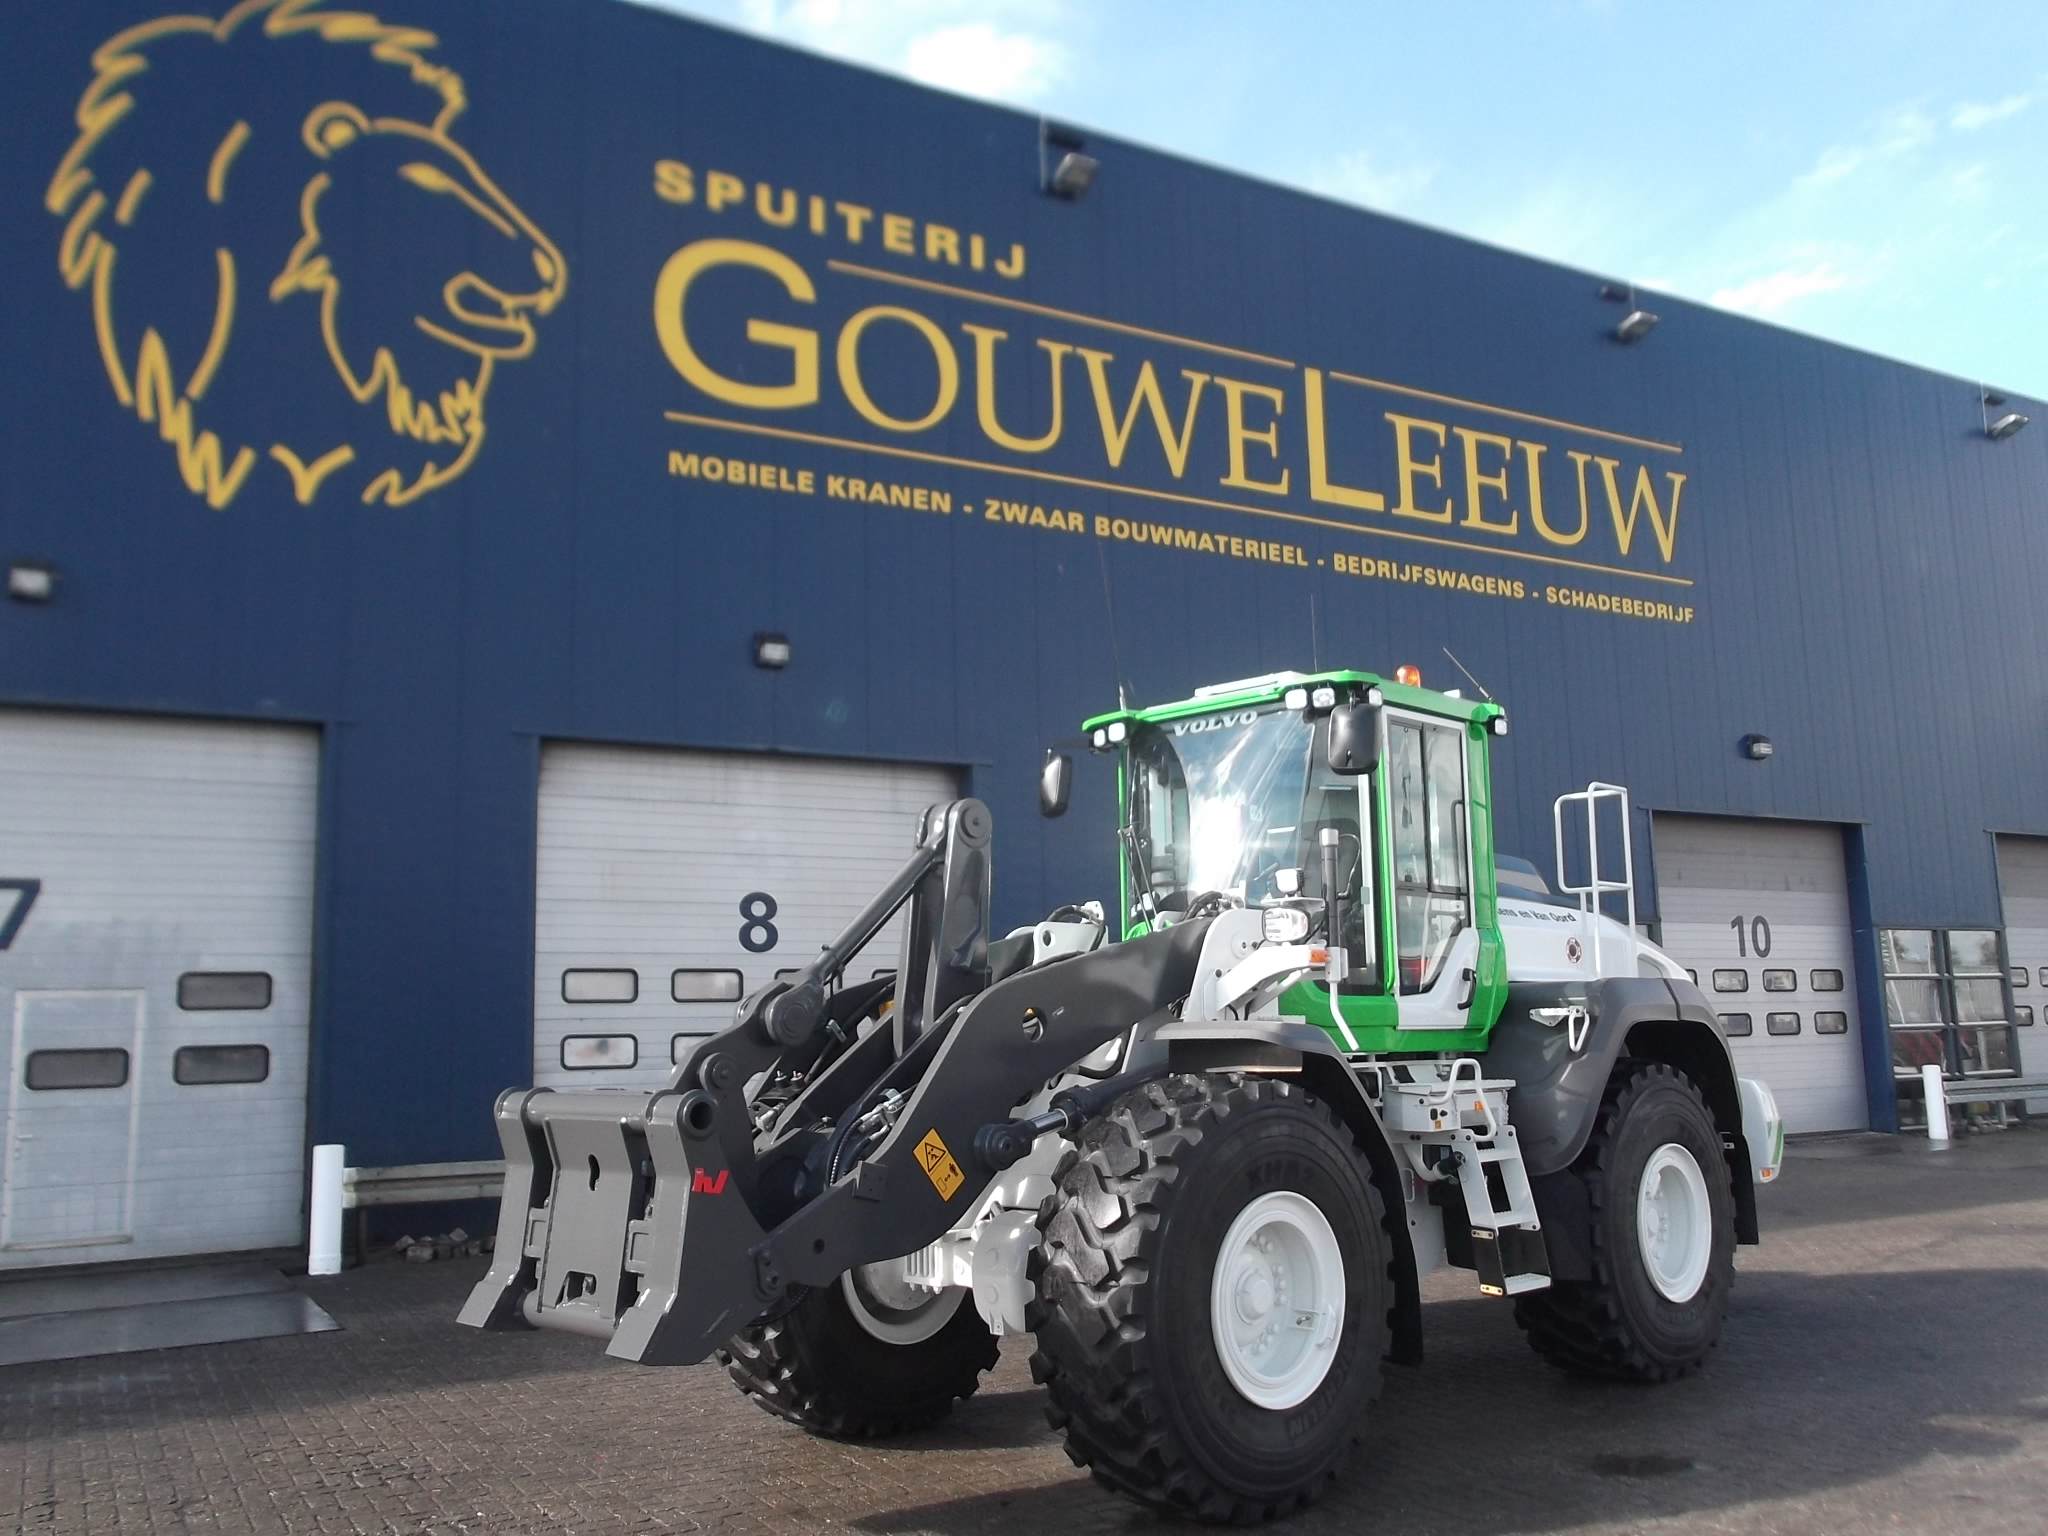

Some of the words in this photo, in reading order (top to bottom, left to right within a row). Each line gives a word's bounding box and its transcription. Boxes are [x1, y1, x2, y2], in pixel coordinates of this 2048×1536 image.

[654, 158, 1026, 279] SPUITERIJ
[667, 450, 815, 495] MOBIELE
[826, 475, 952, 514] KRANEN
[984, 498, 1086, 533] ZWAAR
[1094, 515, 1309, 567] BOUWMATERIEEL
[1333, 552, 1526, 599] BEDRIJFSWAGENS
[1545, 585, 1694, 624] SCHADEBEDRIJF
[1173, 710, 1258, 737] VOLVO
[0, 877, 41, 950] 7
[738, 891, 779, 953] 8
[1730, 915, 1772, 959] 10
